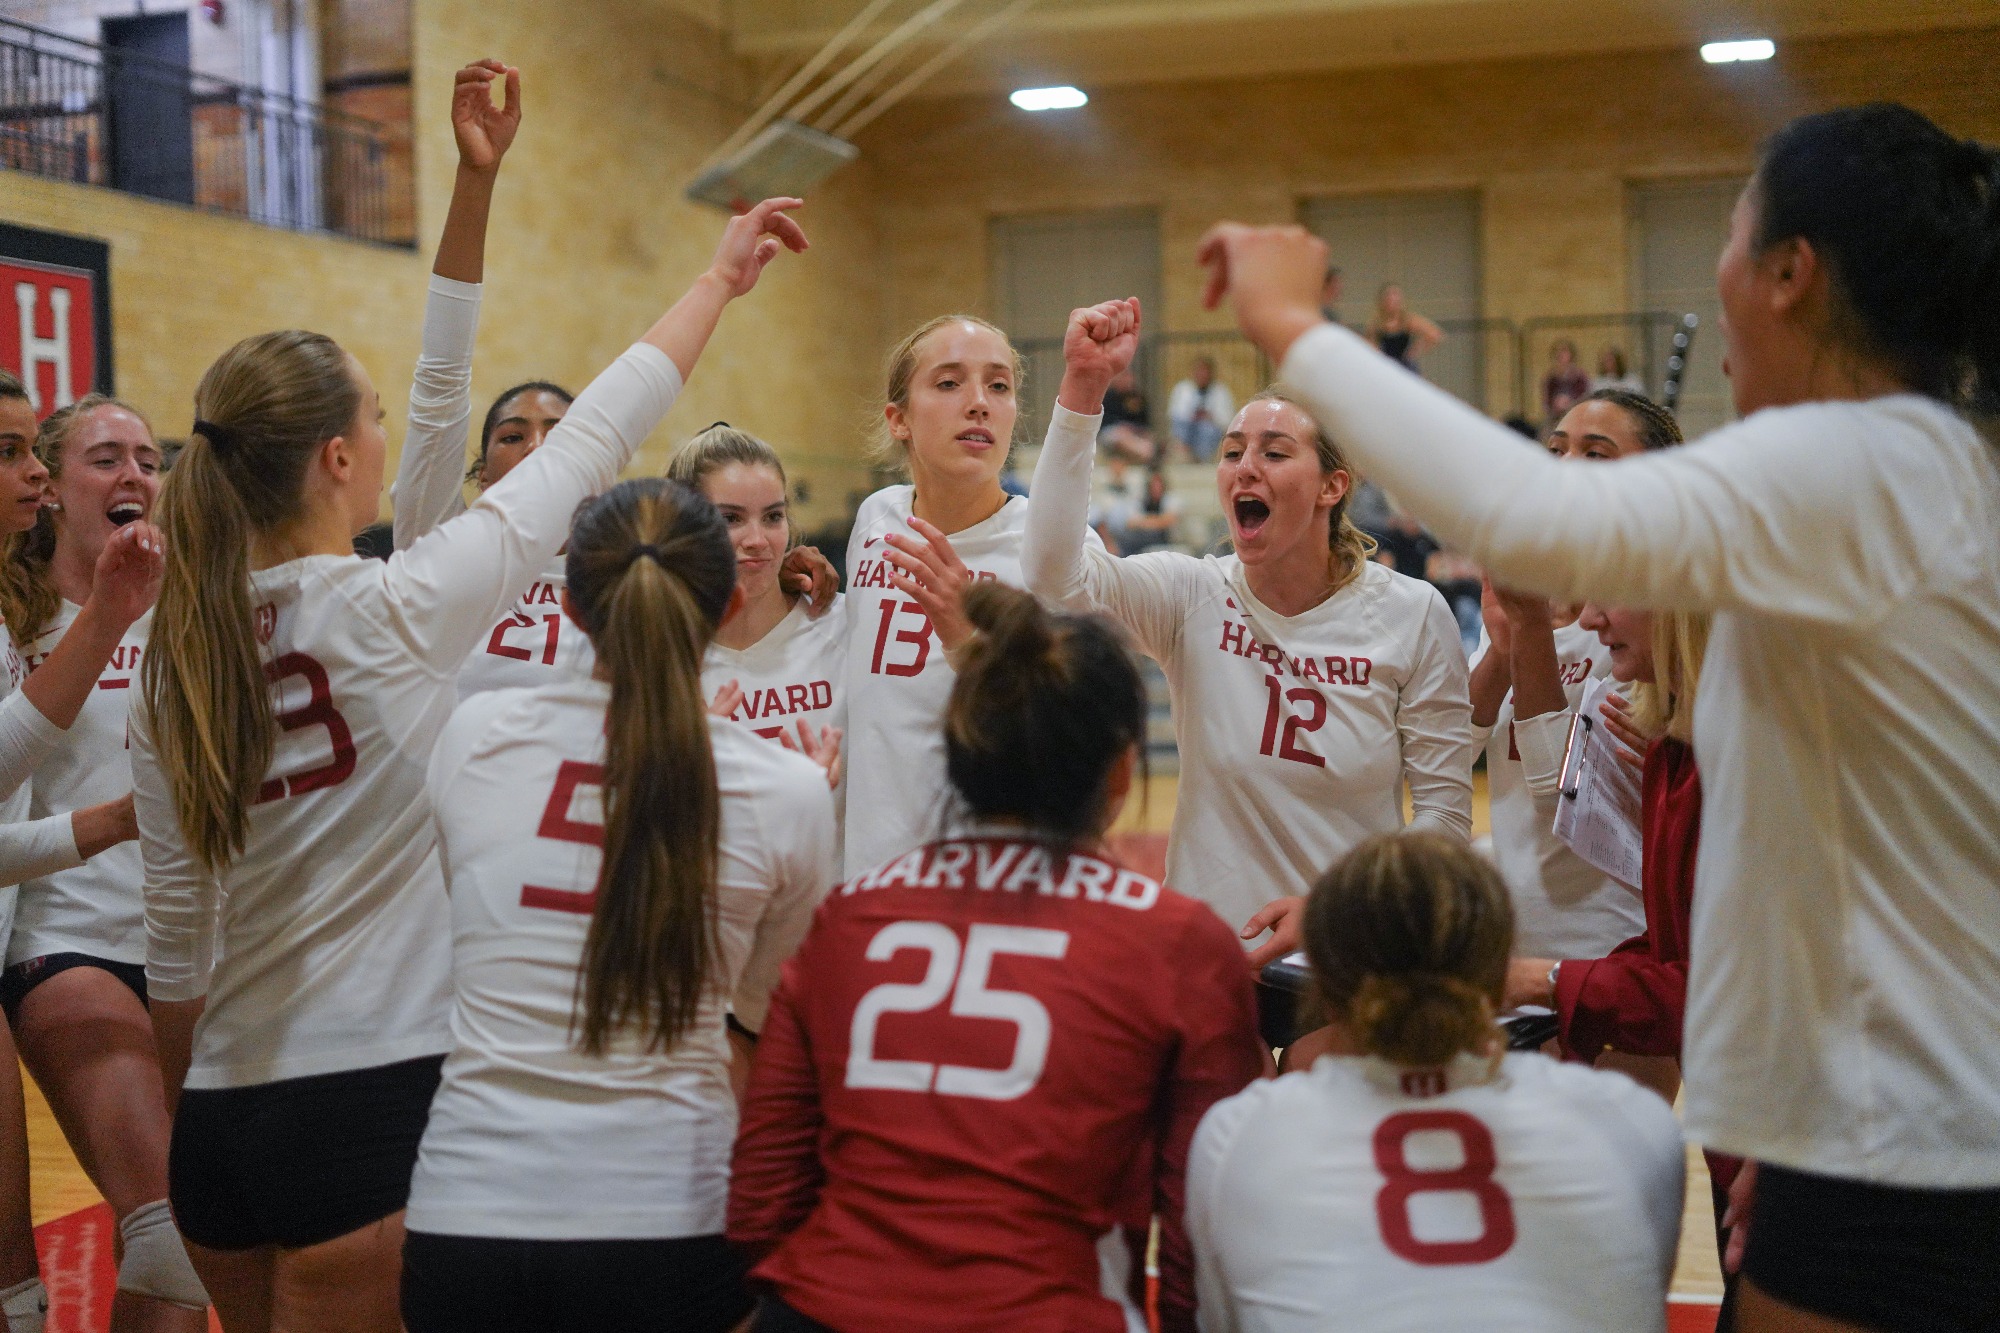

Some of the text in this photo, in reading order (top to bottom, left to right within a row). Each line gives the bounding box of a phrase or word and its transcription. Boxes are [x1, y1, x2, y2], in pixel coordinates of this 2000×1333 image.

[486, 608, 560, 666] 21
[870, 598, 934, 677] 13
[1219, 620, 1372, 686] HARVARD
[251, 652, 357, 805] 3
[730, 680, 833, 722] VARD
[1260, 674, 1327, 768] 12
[841, 843, 1161, 911] HARVARD
[845, 919, 1070, 1101] 25
[1372, 1108, 1518, 1268] 8
